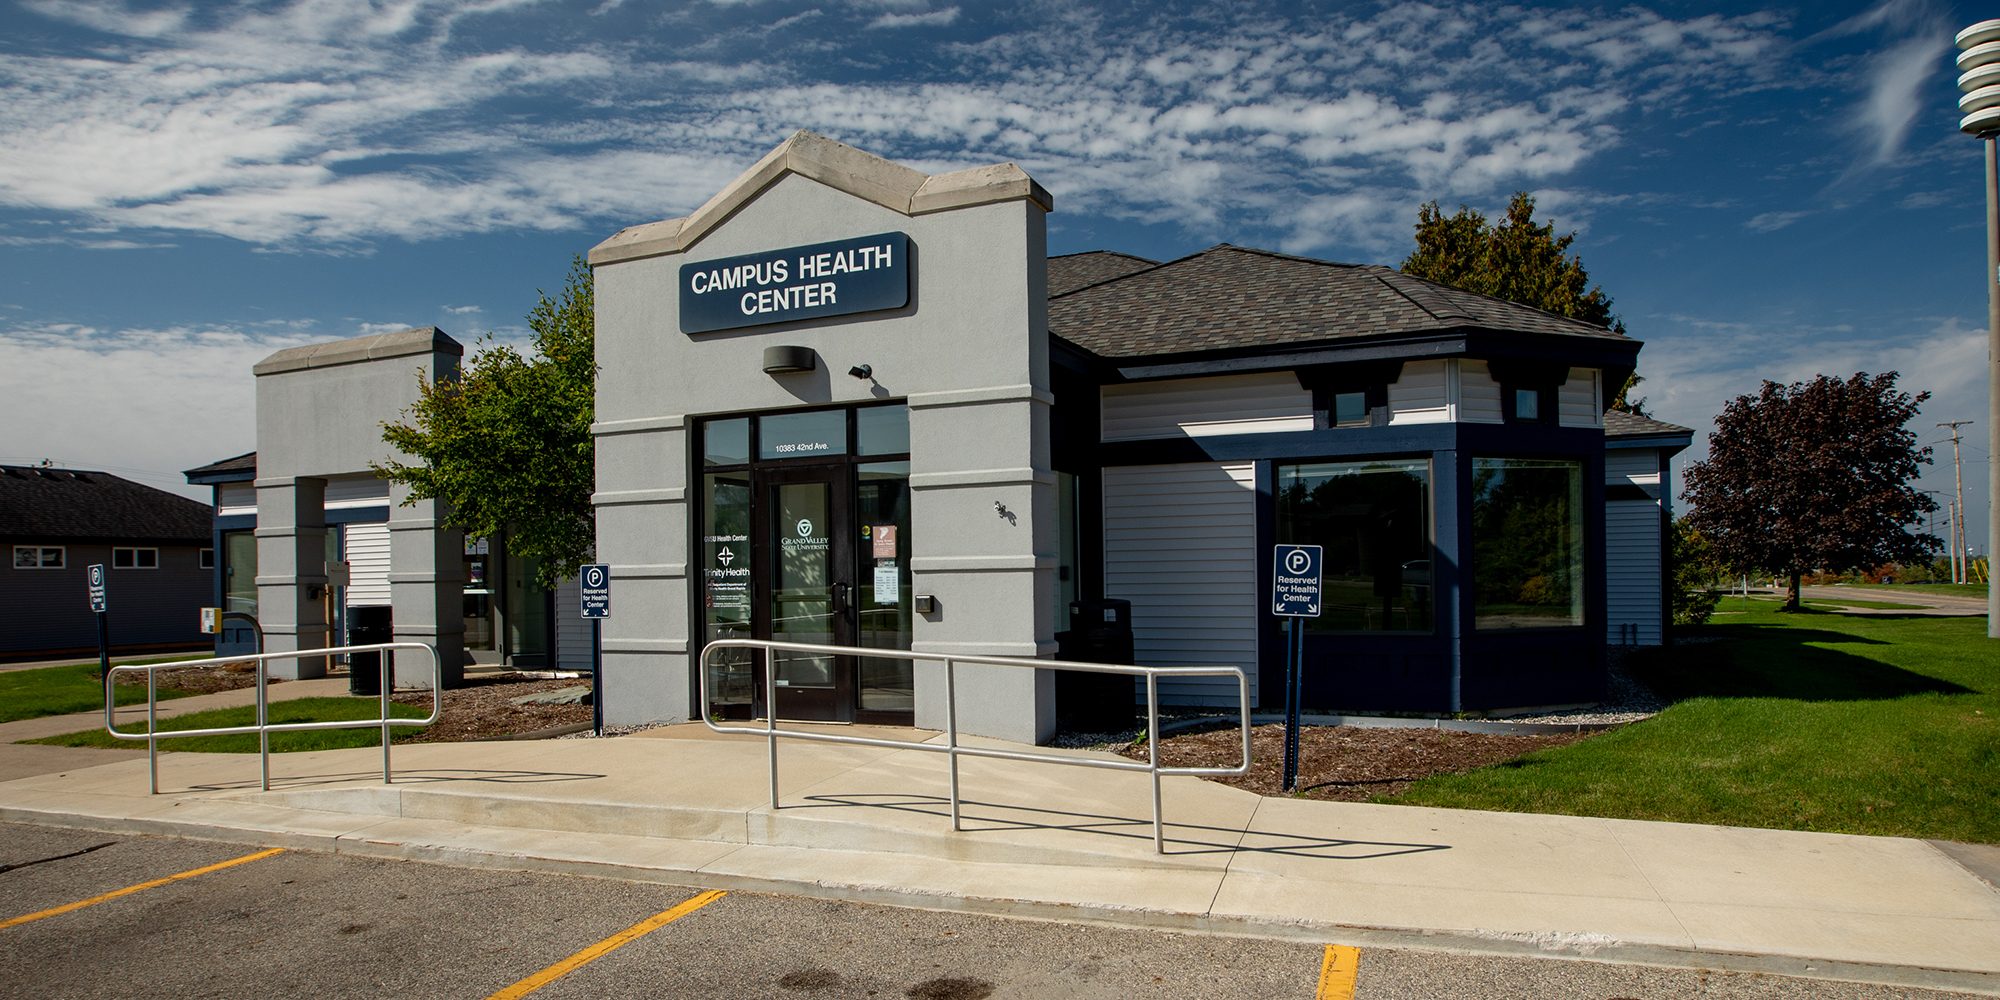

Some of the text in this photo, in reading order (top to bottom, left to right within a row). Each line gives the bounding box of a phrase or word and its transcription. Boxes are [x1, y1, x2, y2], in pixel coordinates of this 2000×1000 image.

[691, 244, 892, 295] CAMPUS HEALTH
[740, 282, 837, 315] CENTER
[776, 444, 795, 452] 10383
[814, 442, 829, 450] Ave.
[732, 534, 747, 542] Center
[781, 536, 829, 545] GRAND VALLEY
[1292, 555, 1304, 569] P
[591, 572, 599, 583] P
[703, 567, 750, 579] Trinity Health
[1278, 575, 1317, 584] Reserved
[1277, 584, 1318, 593] for Health
[1282, 593, 1311, 602] Center
